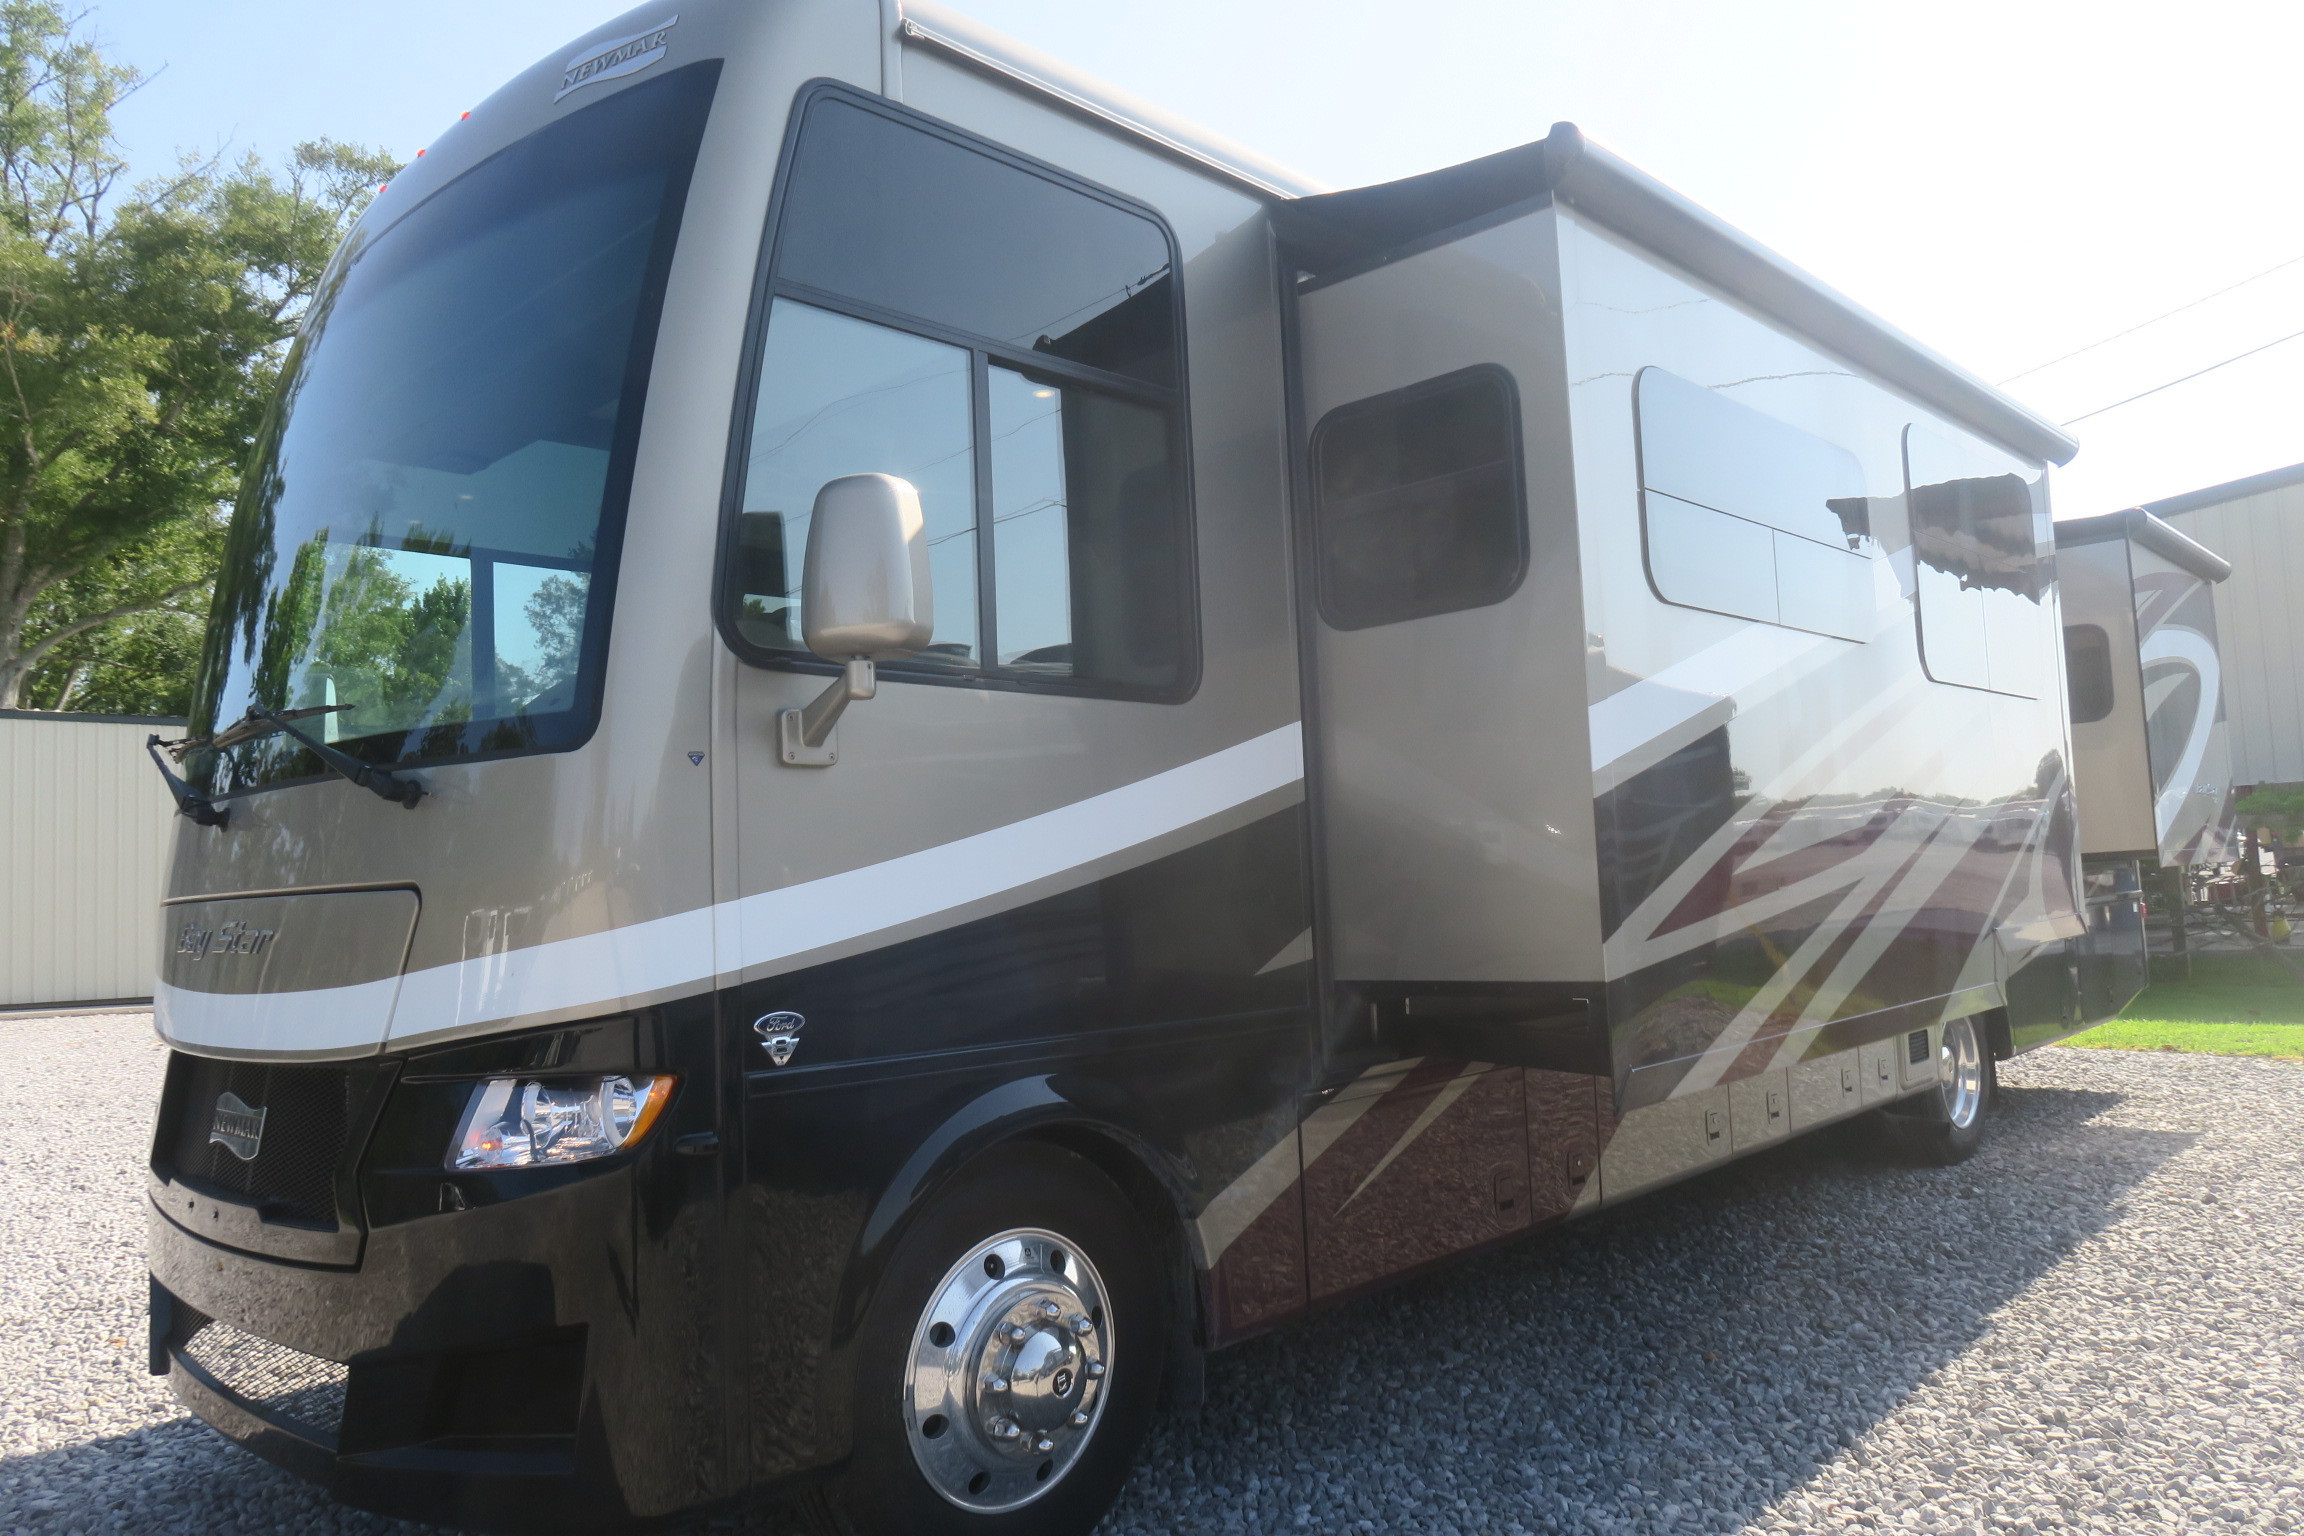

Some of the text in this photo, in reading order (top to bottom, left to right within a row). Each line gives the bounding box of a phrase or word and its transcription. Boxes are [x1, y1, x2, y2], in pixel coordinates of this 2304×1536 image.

[560, 30, 668, 90] NEWMAR
[211, 920, 275, 955] Star
[766, 1015, 797, 1032] Ford
